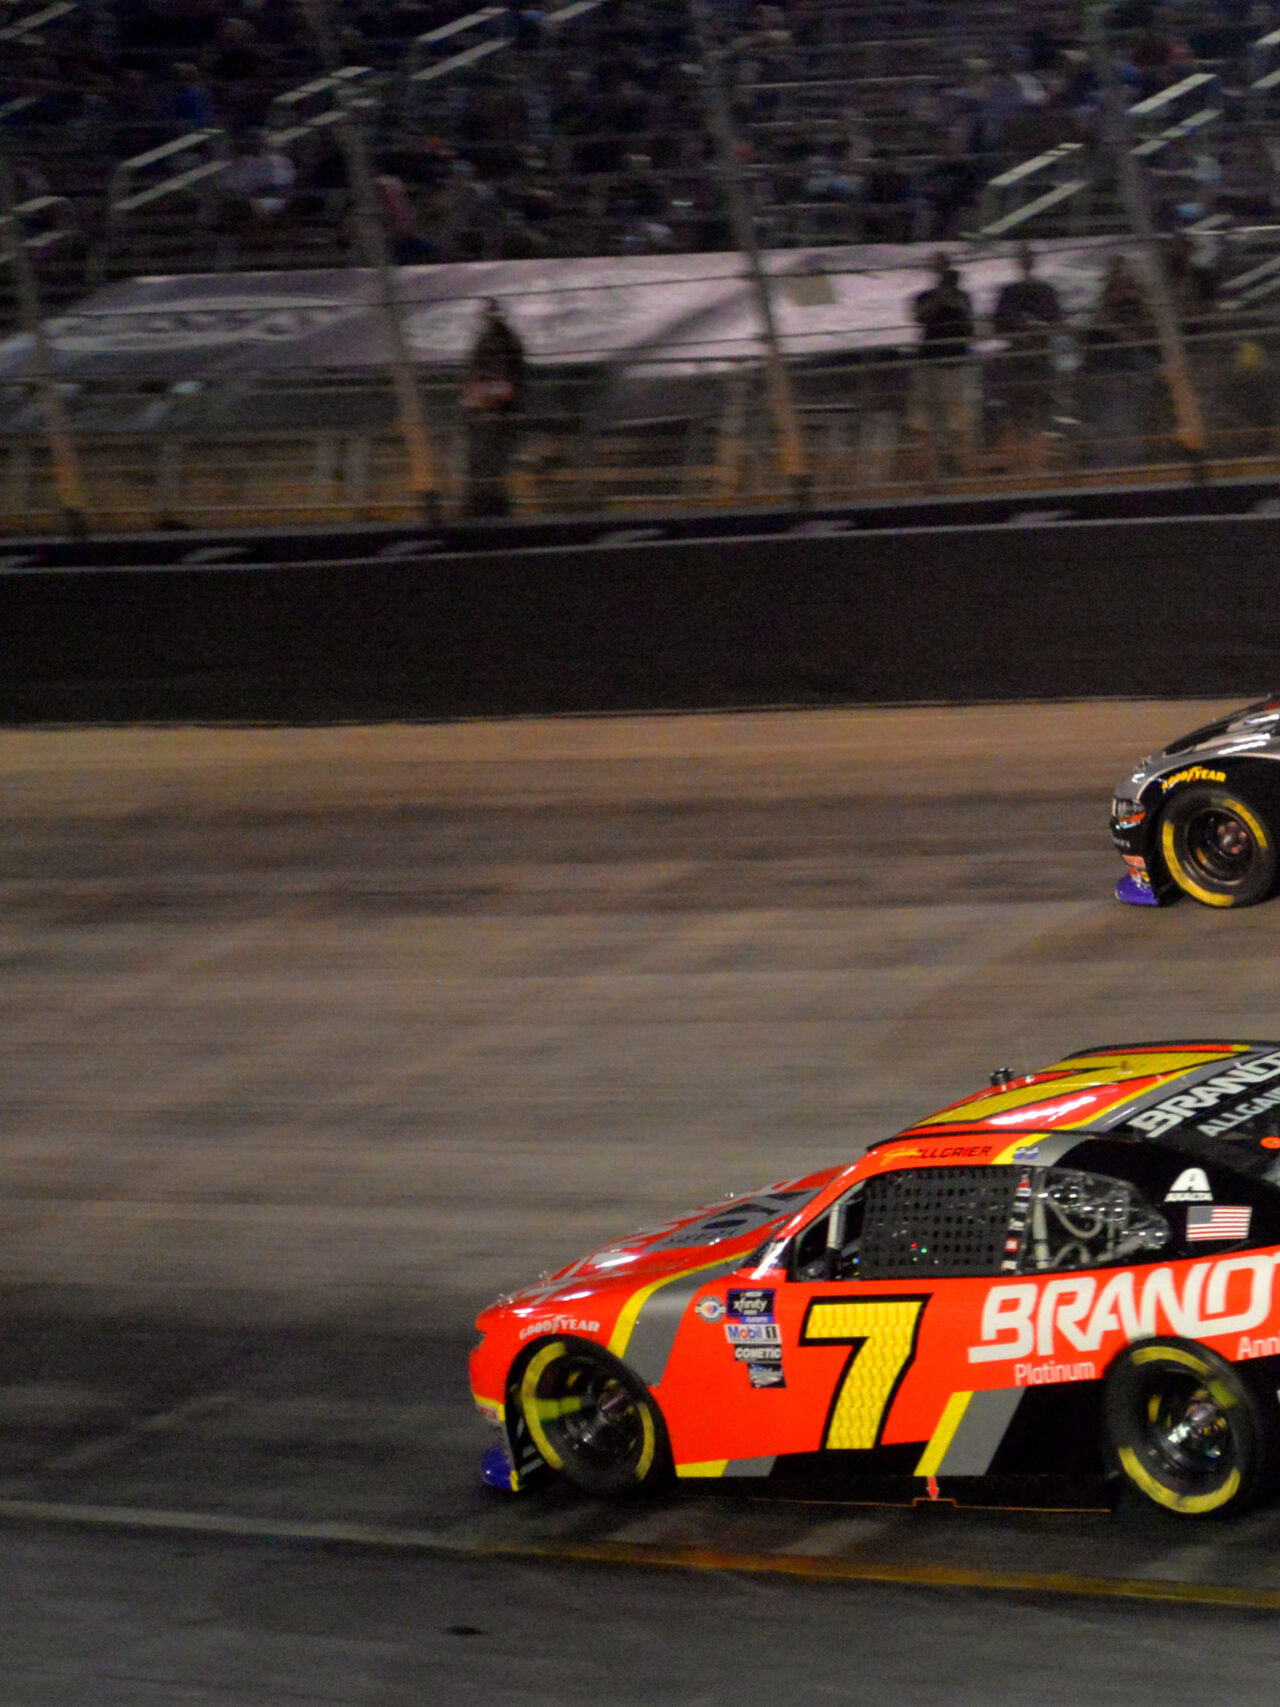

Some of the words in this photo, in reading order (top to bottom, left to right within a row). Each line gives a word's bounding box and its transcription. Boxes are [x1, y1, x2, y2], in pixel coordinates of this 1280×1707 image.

[733, 1298, 768, 1312] xfinity
[519, 1314, 600, 1340] GOODYEAR
[727, 1325, 763, 1339] Mobil
[735, 1346, 782, 1360] COMETIC
[797, 1292, 934, 1452] 7
[1014, 1361, 1096, 1386] Platinum
